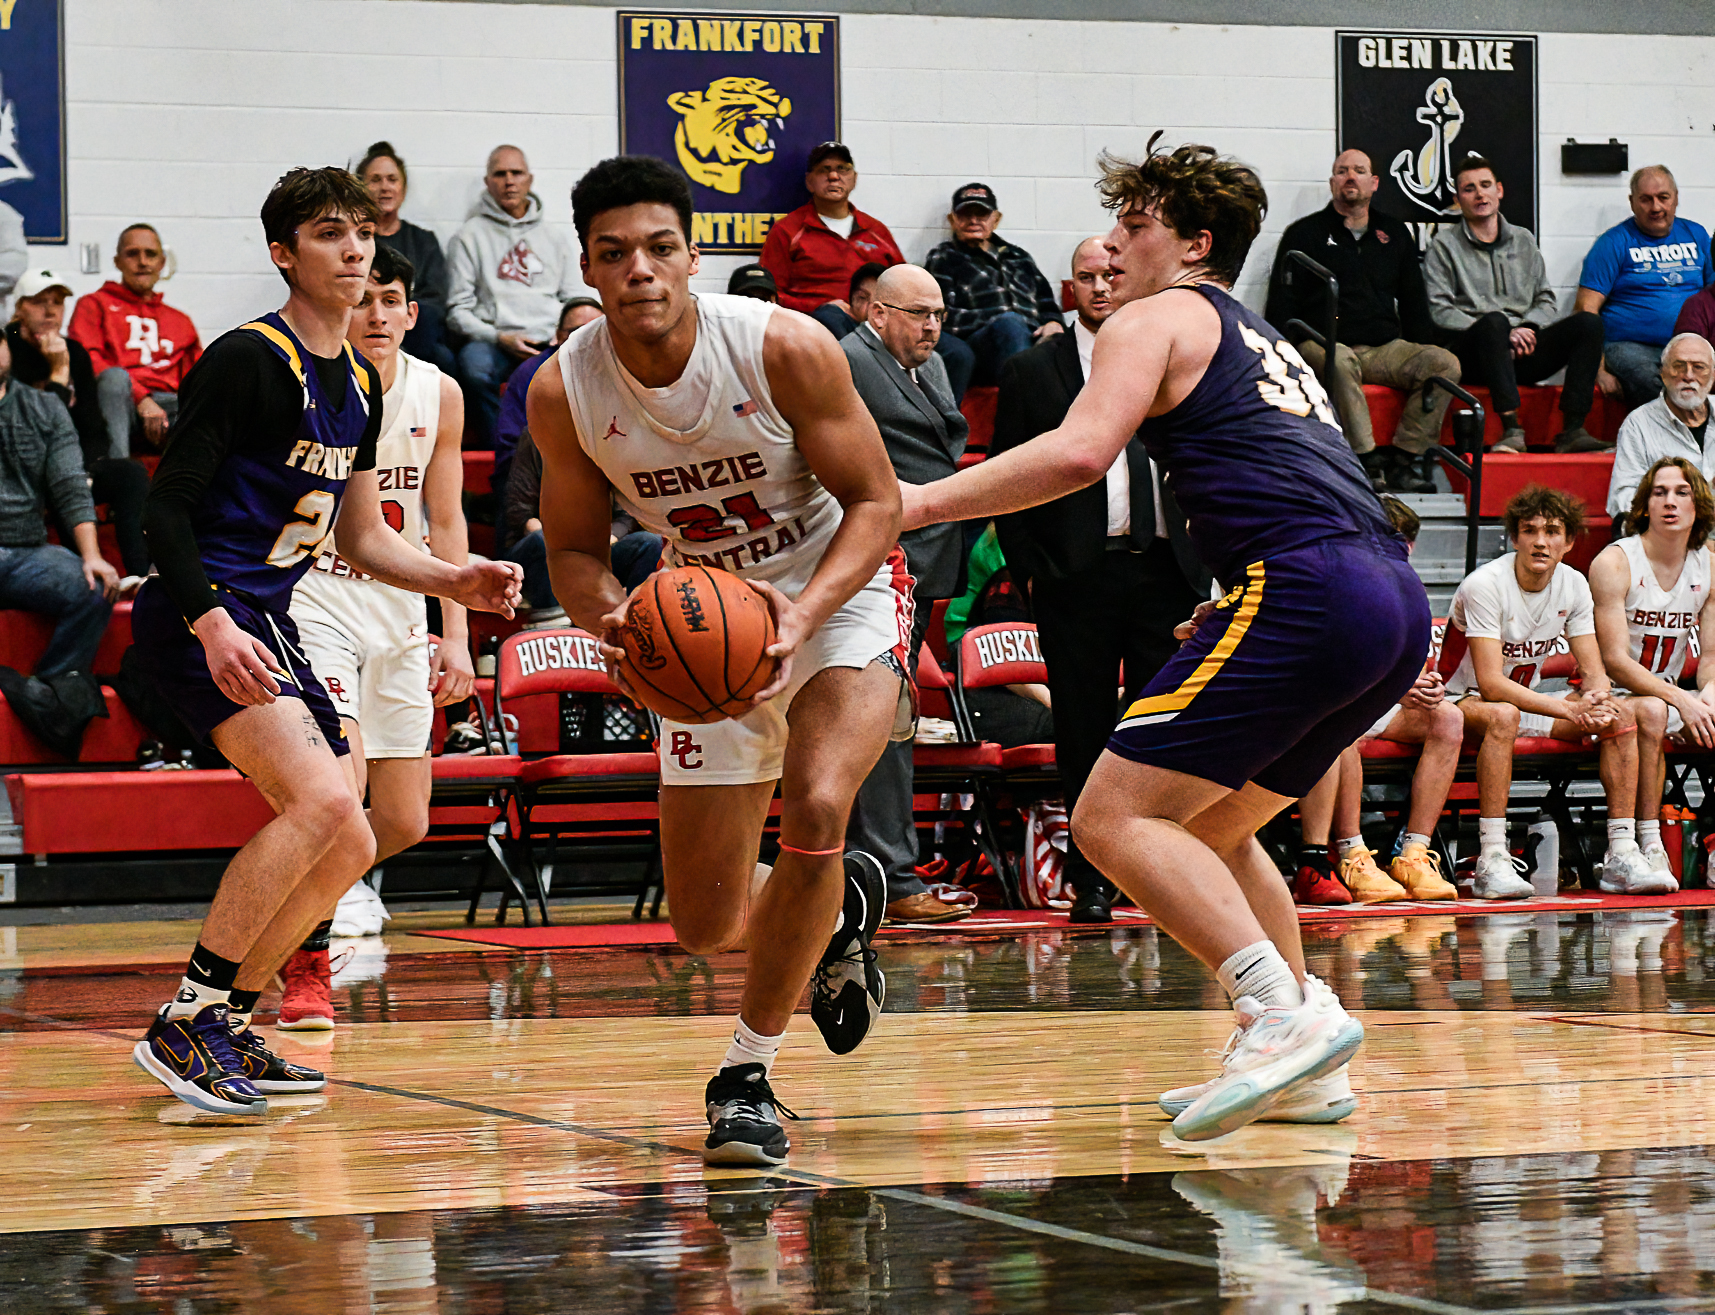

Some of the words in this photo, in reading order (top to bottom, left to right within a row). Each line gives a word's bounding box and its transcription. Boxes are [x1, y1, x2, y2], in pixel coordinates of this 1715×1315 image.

[631, 18, 824, 54] FRANKFORT
[1358, 38, 1432, 69] GLEN
[1439, 39, 1514, 71] LAKE
[691, 212, 788, 244] NTHE
[1629, 242, 1698, 263] DETROIT
[377, 466, 419, 491] ZIE
[630, 451, 767, 498] BENZIE
[265, 489, 335, 568] 2
[667, 491, 775, 542] 21
[1632, 609, 1692, 629] BENZIE
[974, 630, 1045, 669] HUSKI
[1638, 634, 1677, 674] 11
[670, 731, 703, 769] BC
